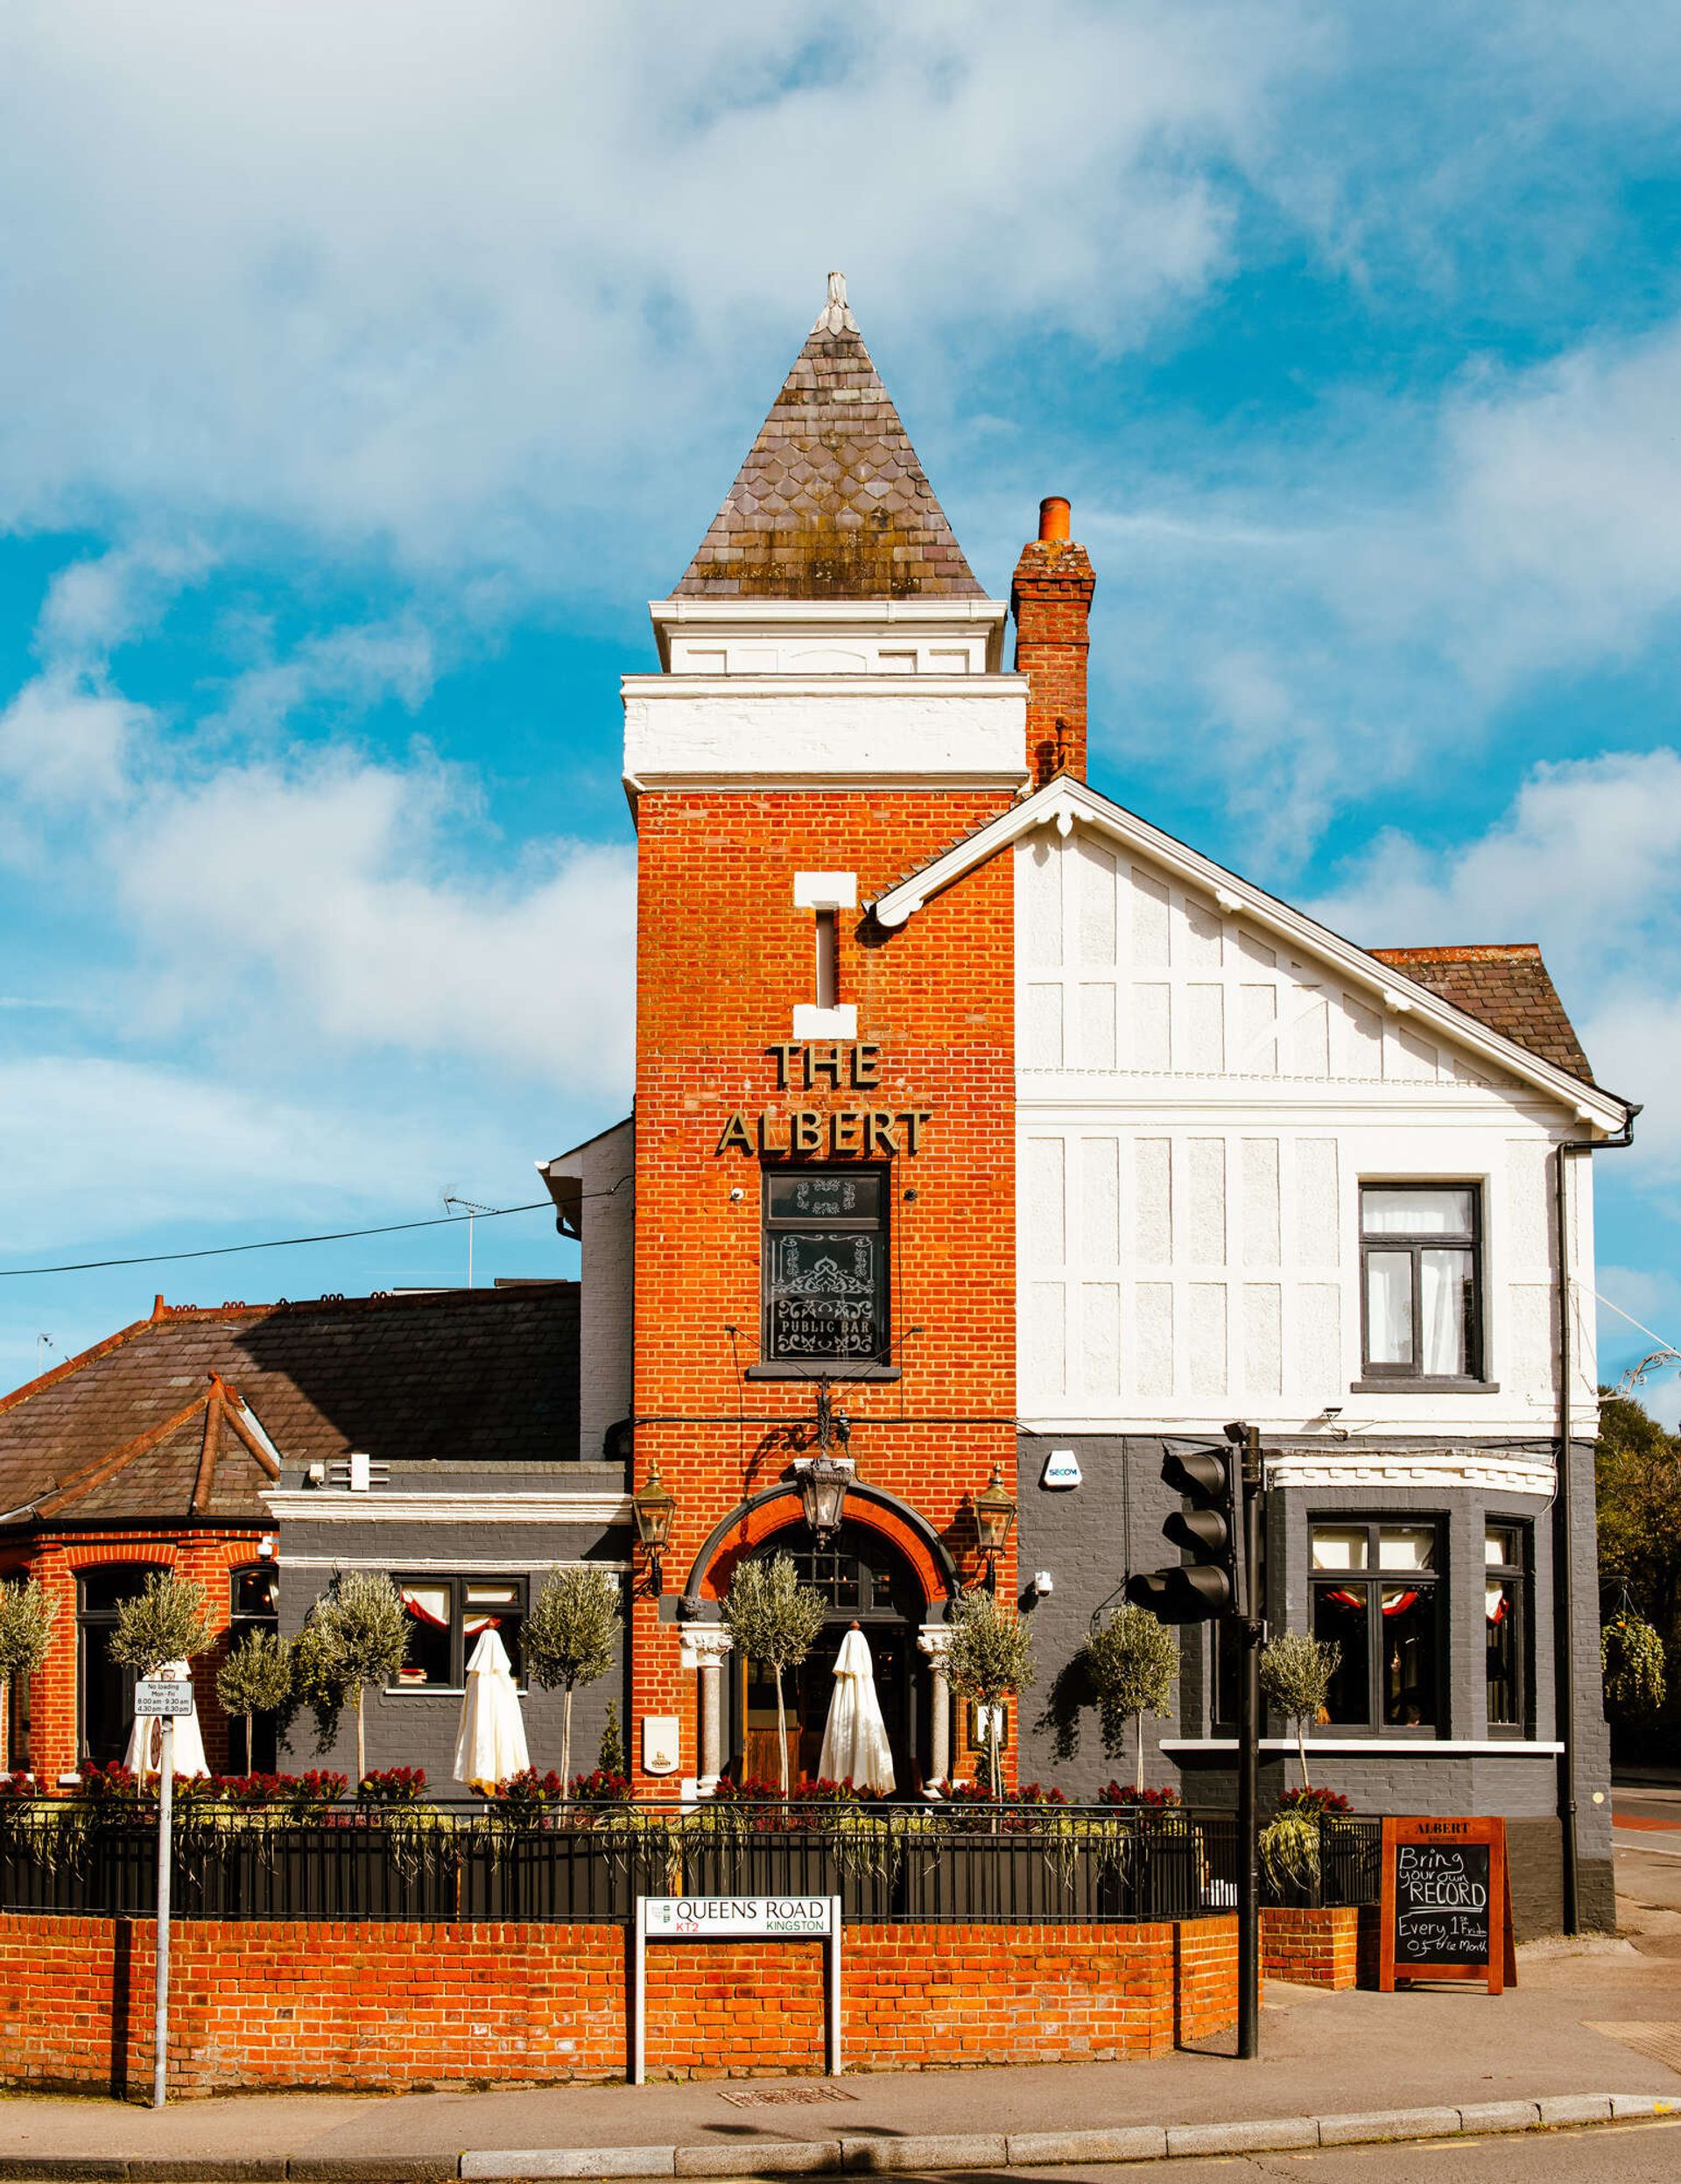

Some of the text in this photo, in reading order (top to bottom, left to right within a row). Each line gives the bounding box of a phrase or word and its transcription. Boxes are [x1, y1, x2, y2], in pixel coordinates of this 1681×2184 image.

[770, 1042, 883, 1084] THE
[718, 1109, 933, 1152] ALBERT
[782, 1321, 869, 1333] PUBLIC BAR
[1416, 1823, 1471, 1835] ALBERT
[1399, 1847, 1464, 1873] Bring
[1399, 1870, 1469, 1889] your own
[1410, 1882, 1487, 1906] RECORD
[677, 1901, 757, 1922] QUEENS
[766, 1901, 824, 1919] ROAD
[676, 1920, 824, 1932] KT2 KINGSTON
[1398, 1913, 1446, 1941] Every
[1436, 1935, 1457, 1951] the
[1459, 1940, 1488, 1953] Month
